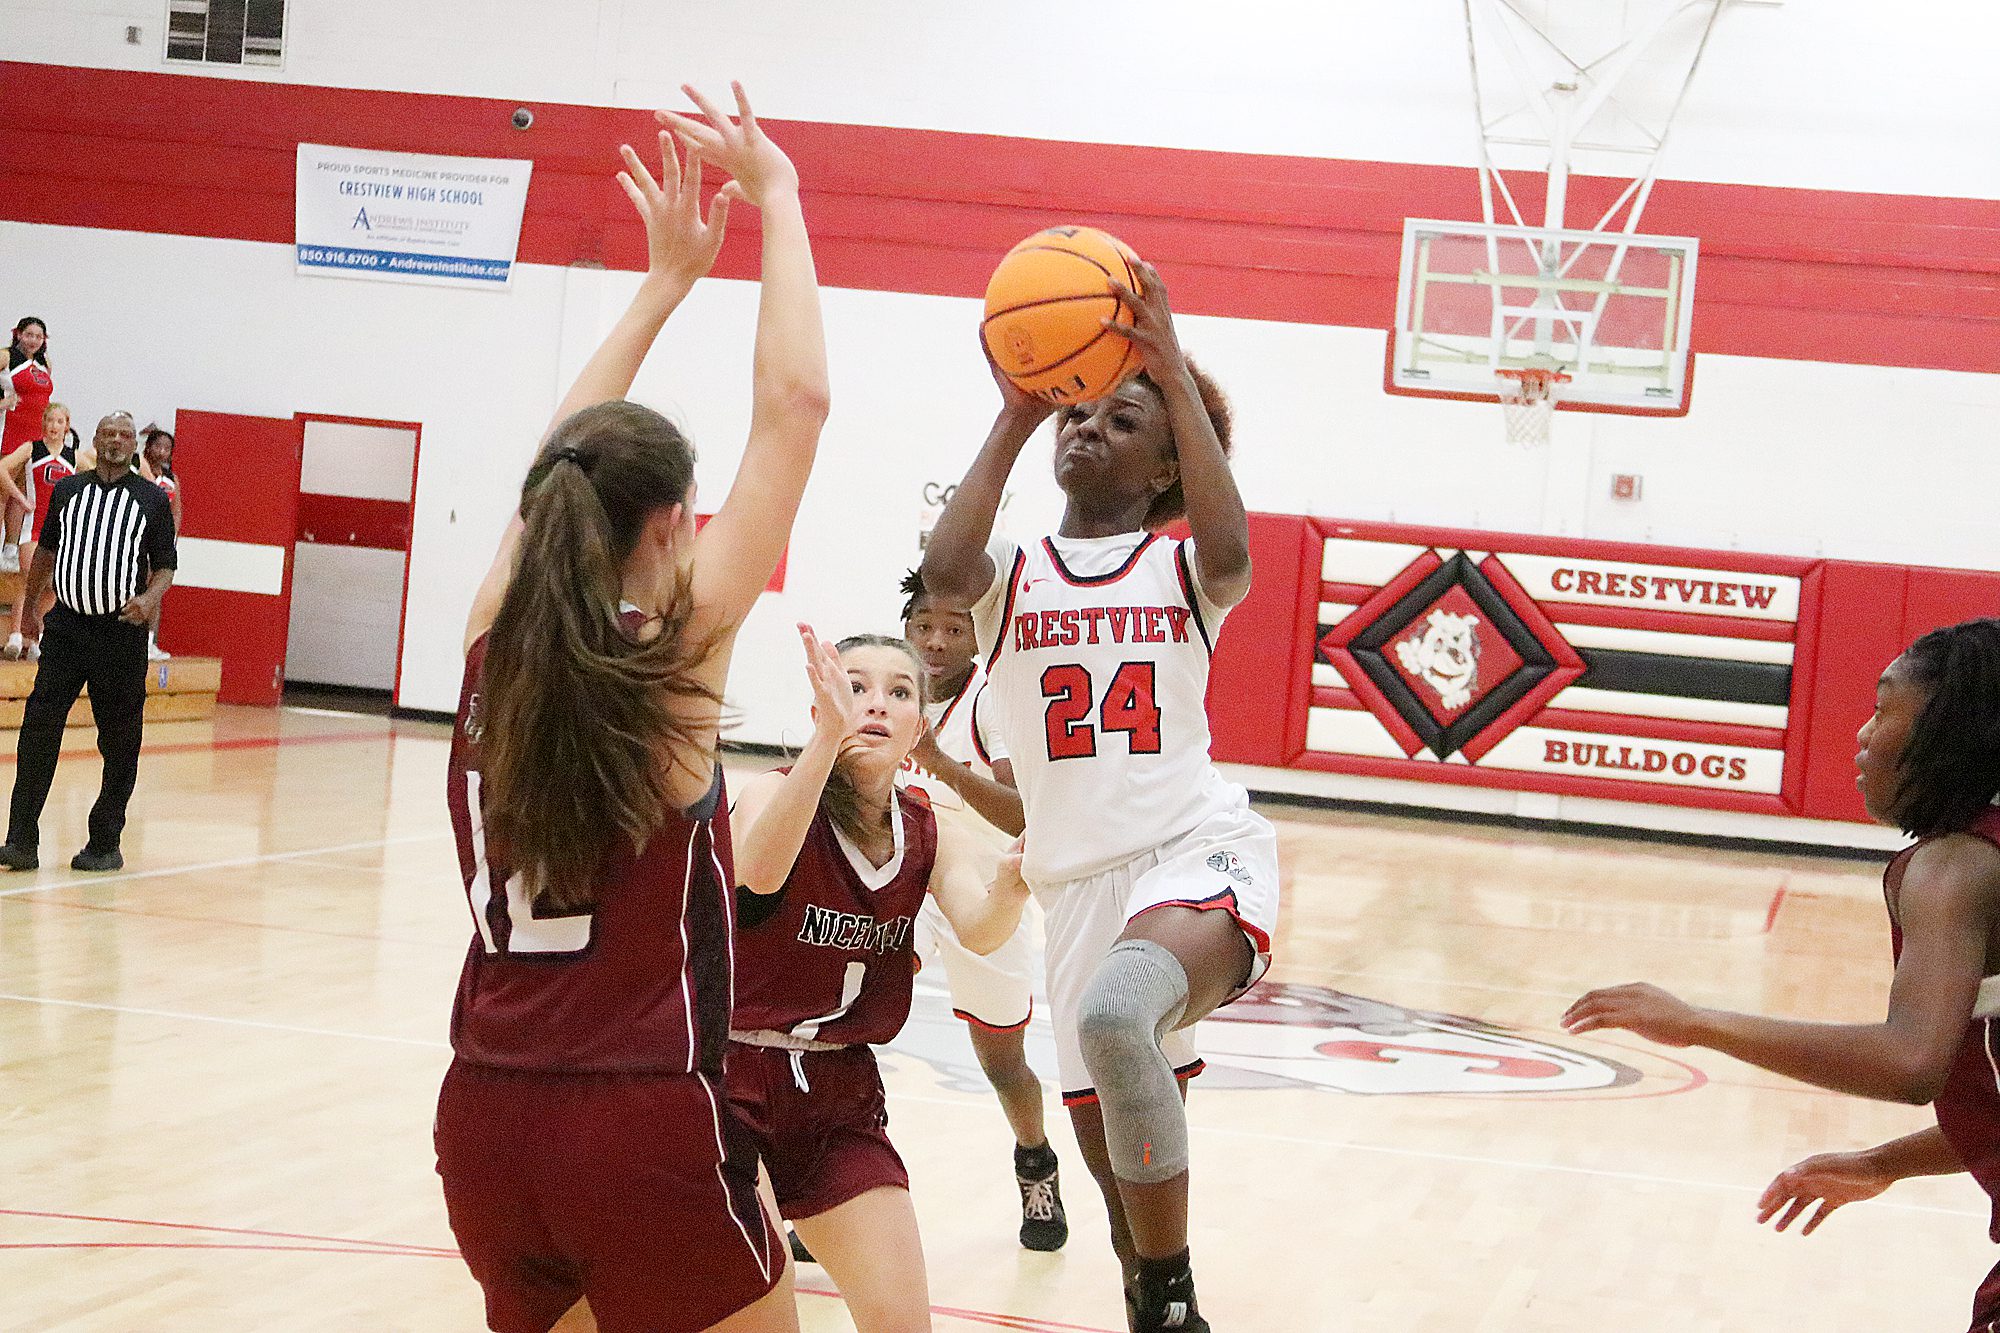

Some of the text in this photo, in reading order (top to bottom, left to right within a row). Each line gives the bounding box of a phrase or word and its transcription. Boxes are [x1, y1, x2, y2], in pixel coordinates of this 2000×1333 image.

[317, 162, 509, 185] PROUD SPORTS MEDICINE PROVIDER FOR
[339, 181, 483, 206] CRESTVIEW HIGH SCHOOL
[352, 206, 414, 231] ANDREWS
[416, 217, 470, 231] INSTITUTE
[1550, 567, 1778, 610] CRESTVIEW
[1040, 660, 1161, 762] 24
[1543, 738, 1748, 781] BULLDOGS
